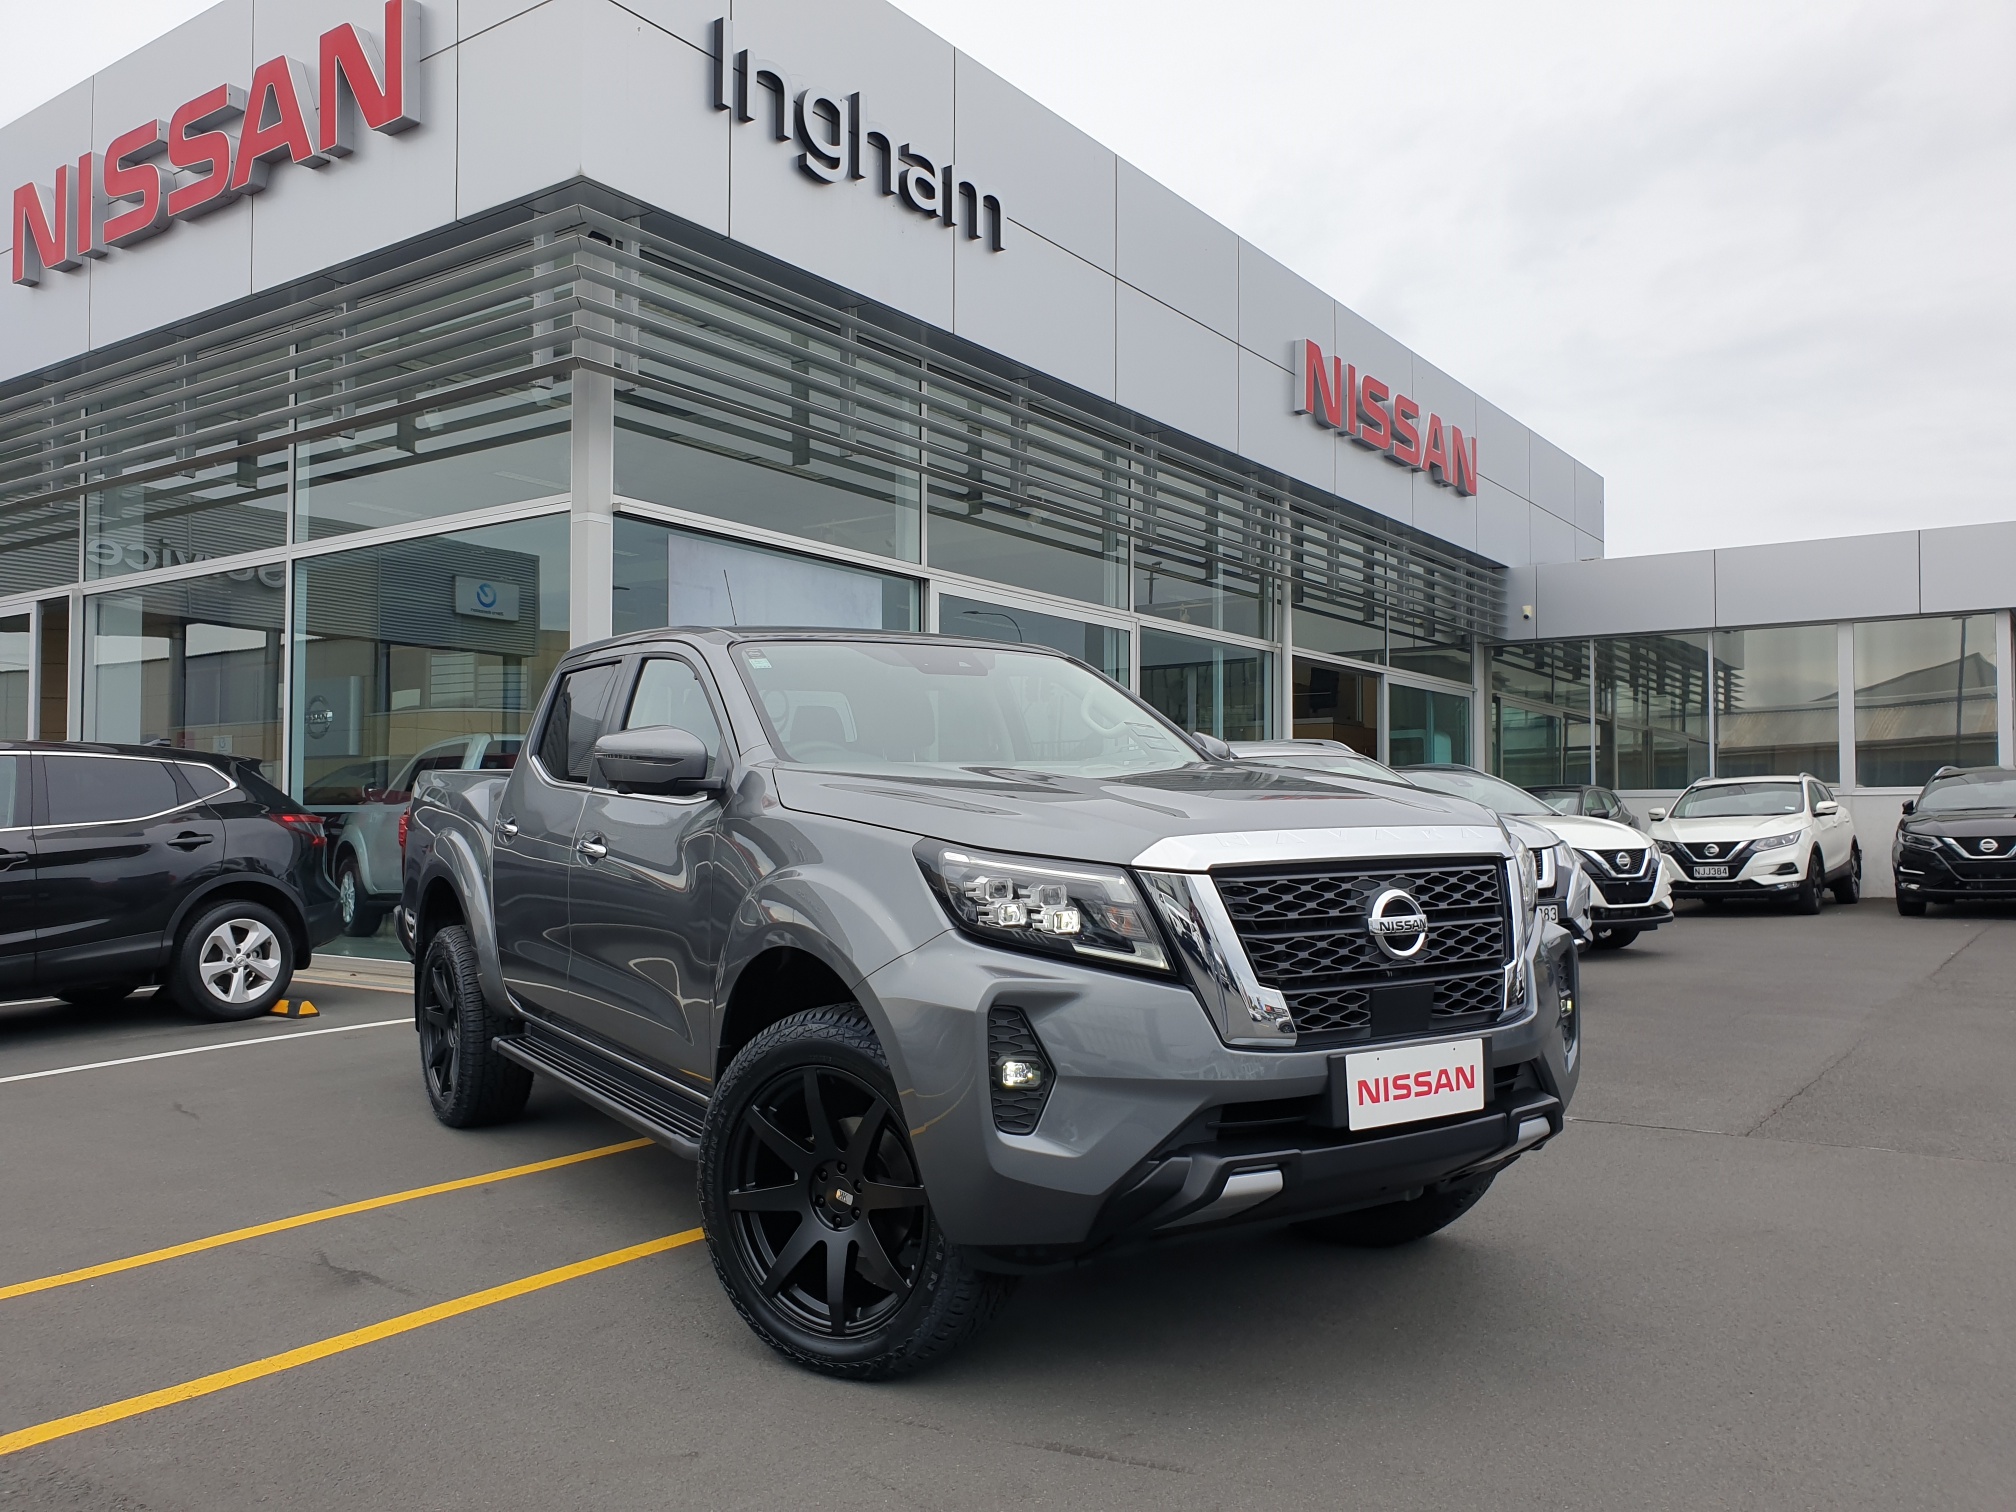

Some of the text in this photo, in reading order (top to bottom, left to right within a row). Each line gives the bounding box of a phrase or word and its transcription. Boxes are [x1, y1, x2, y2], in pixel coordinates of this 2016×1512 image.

[12, 0, 406, 286] NISSAN
[712, 16, 1007, 252] Ingham
[1301, 338, 1477, 497] NISSAN
[1694, 867, 1728, 876] NJJ384
[1379, 918, 1427, 932] NISSAN
[1357, 1064, 1475, 1106] NISSAN
